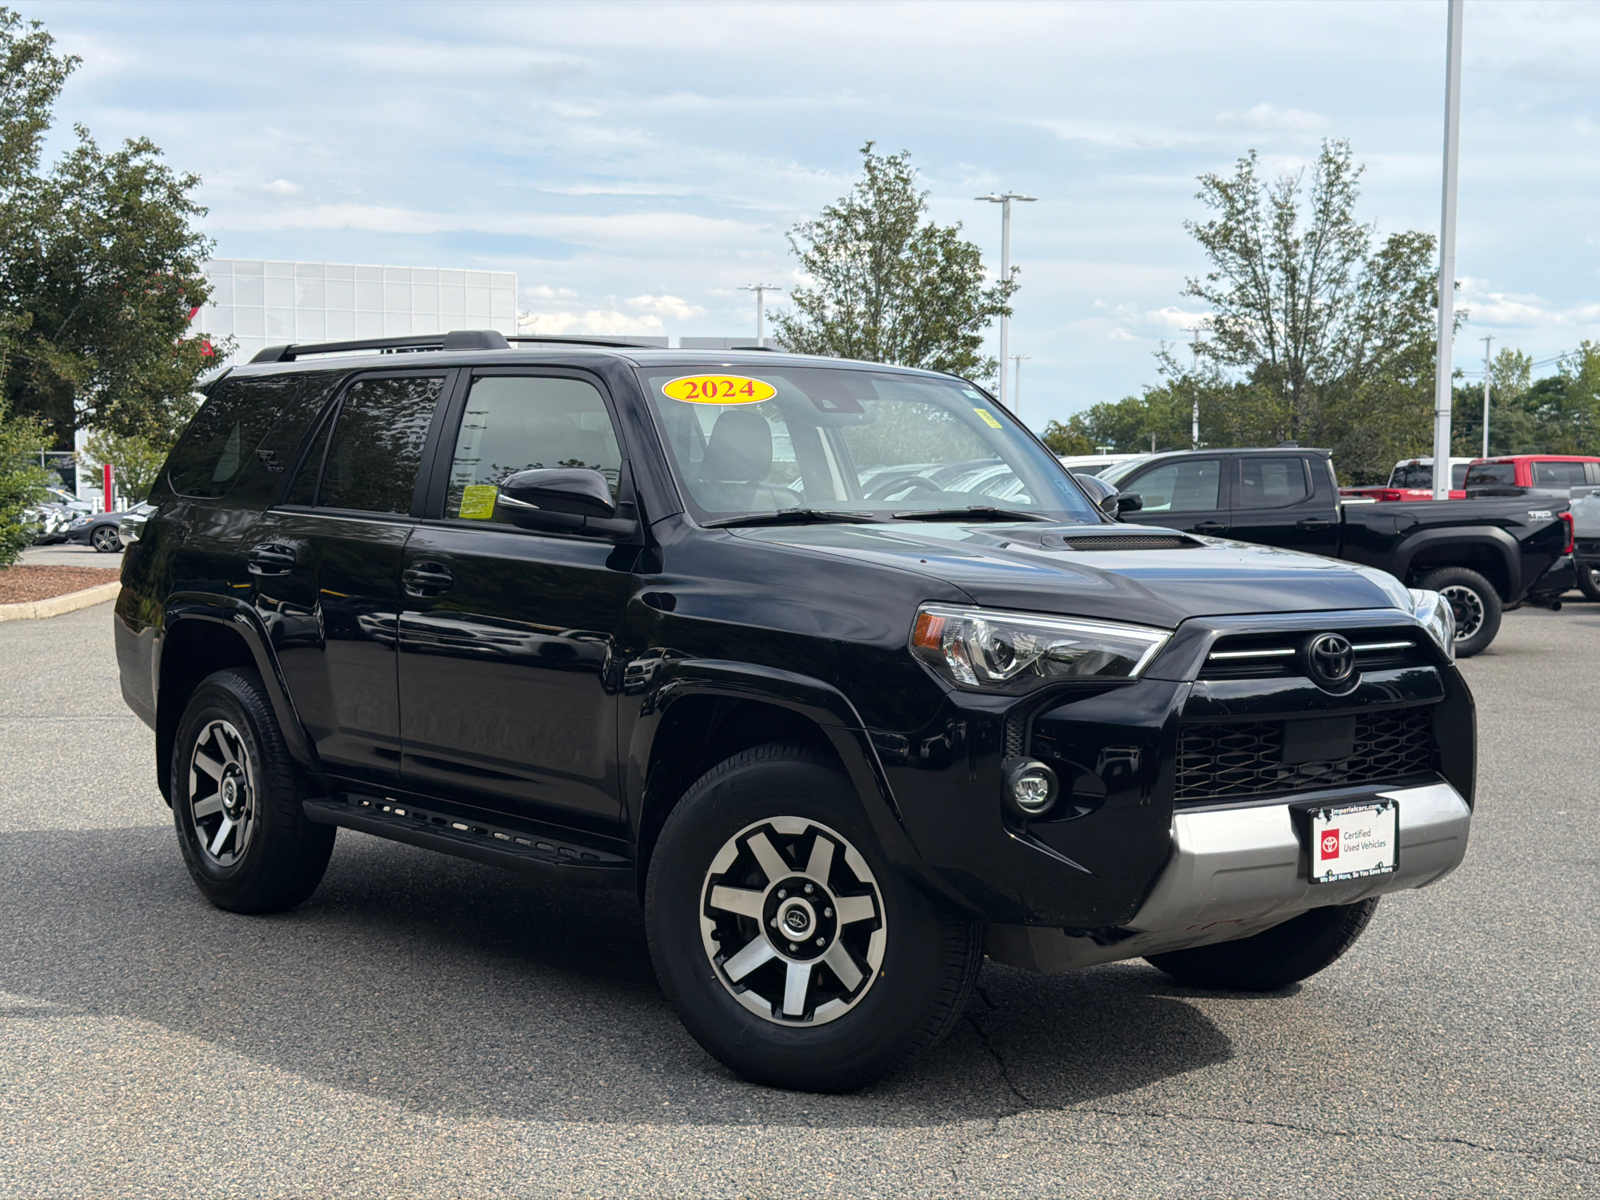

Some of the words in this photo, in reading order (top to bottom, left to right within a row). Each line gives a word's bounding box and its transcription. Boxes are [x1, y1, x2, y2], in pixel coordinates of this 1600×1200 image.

[683, 380, 755, 399] 2024
[1528, 510, 1552, 519] TRD
[1343, 828, 1371, 840] Certified
[1343, 843, 1360, 852] Used
[1360, 839, 1386, 850] Vehicles
